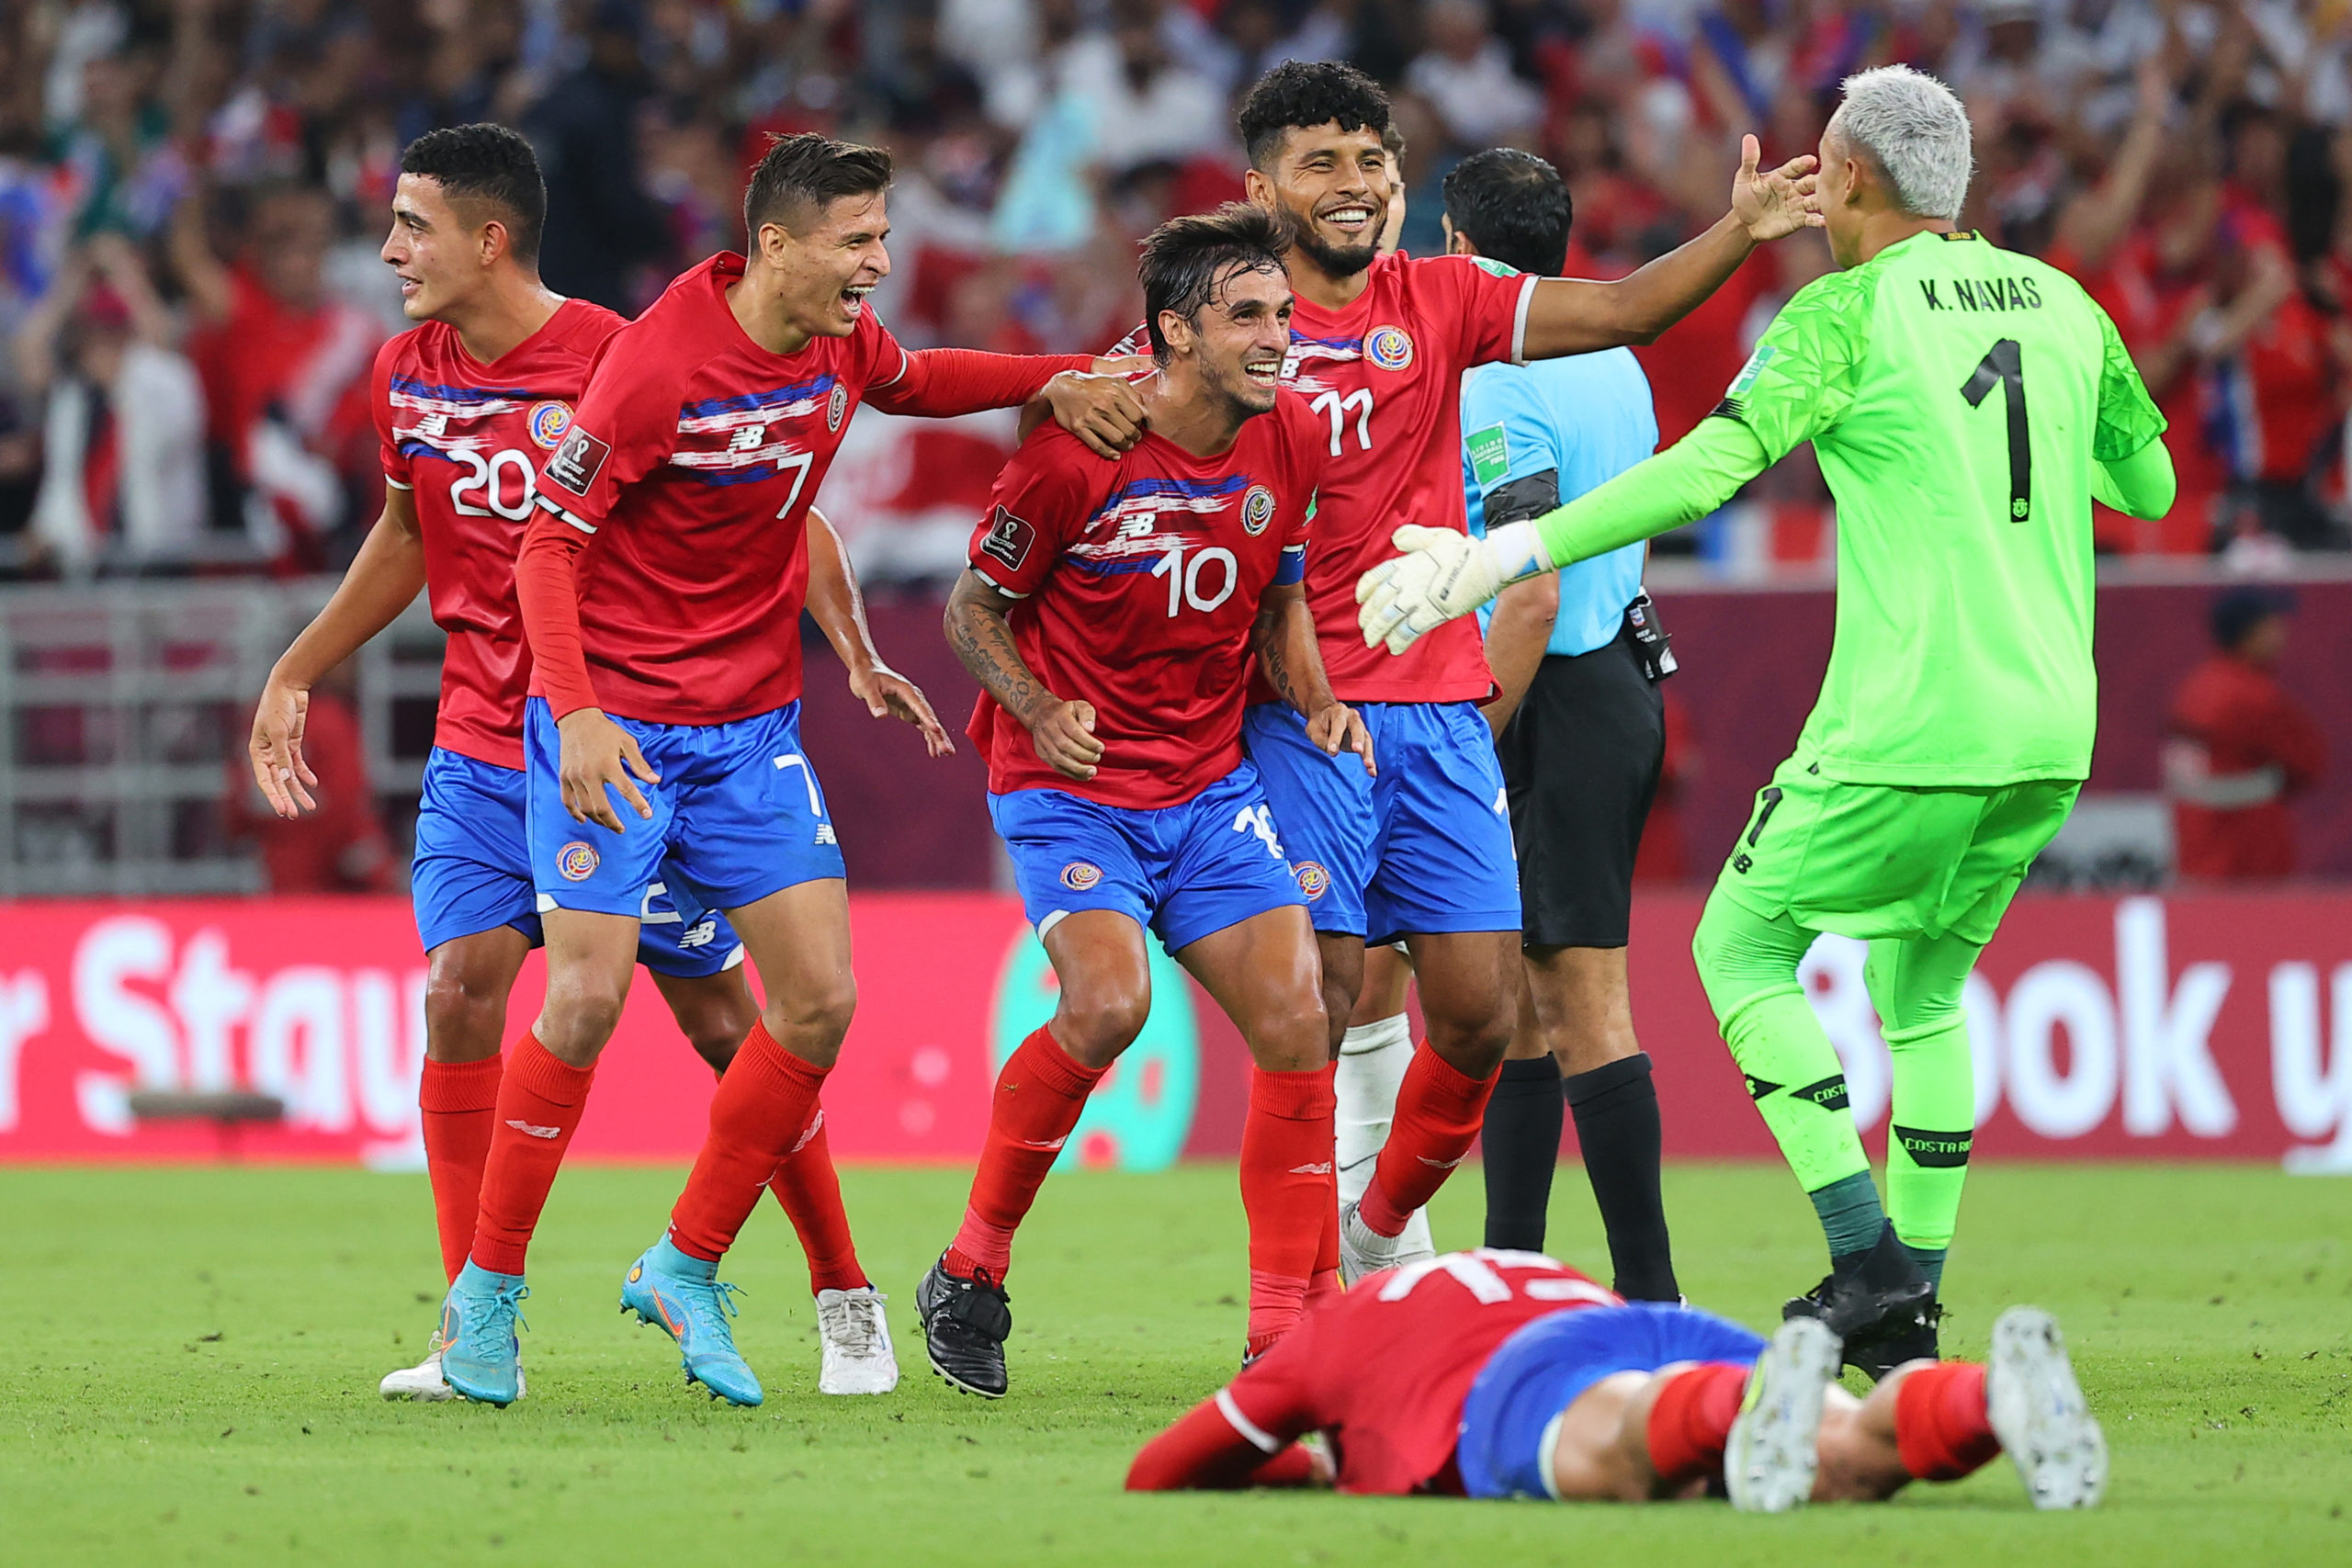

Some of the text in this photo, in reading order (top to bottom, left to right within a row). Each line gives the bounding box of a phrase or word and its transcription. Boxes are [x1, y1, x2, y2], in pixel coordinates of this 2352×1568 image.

[1953, 276, 2042, 311] NAVAS
[1309, 388, 1374, 457] 11
[1960, 338, 2031, 523] 1
[449, 448, 536, 521] 20
[776, 451, 815, 521] 7
[1151, 547, 1238, 617] 10
[773, 753, 822, 818] 7
[1747, 787, 1783, 848] 1
[1905, 1137, 1957, 1154] COSTA
